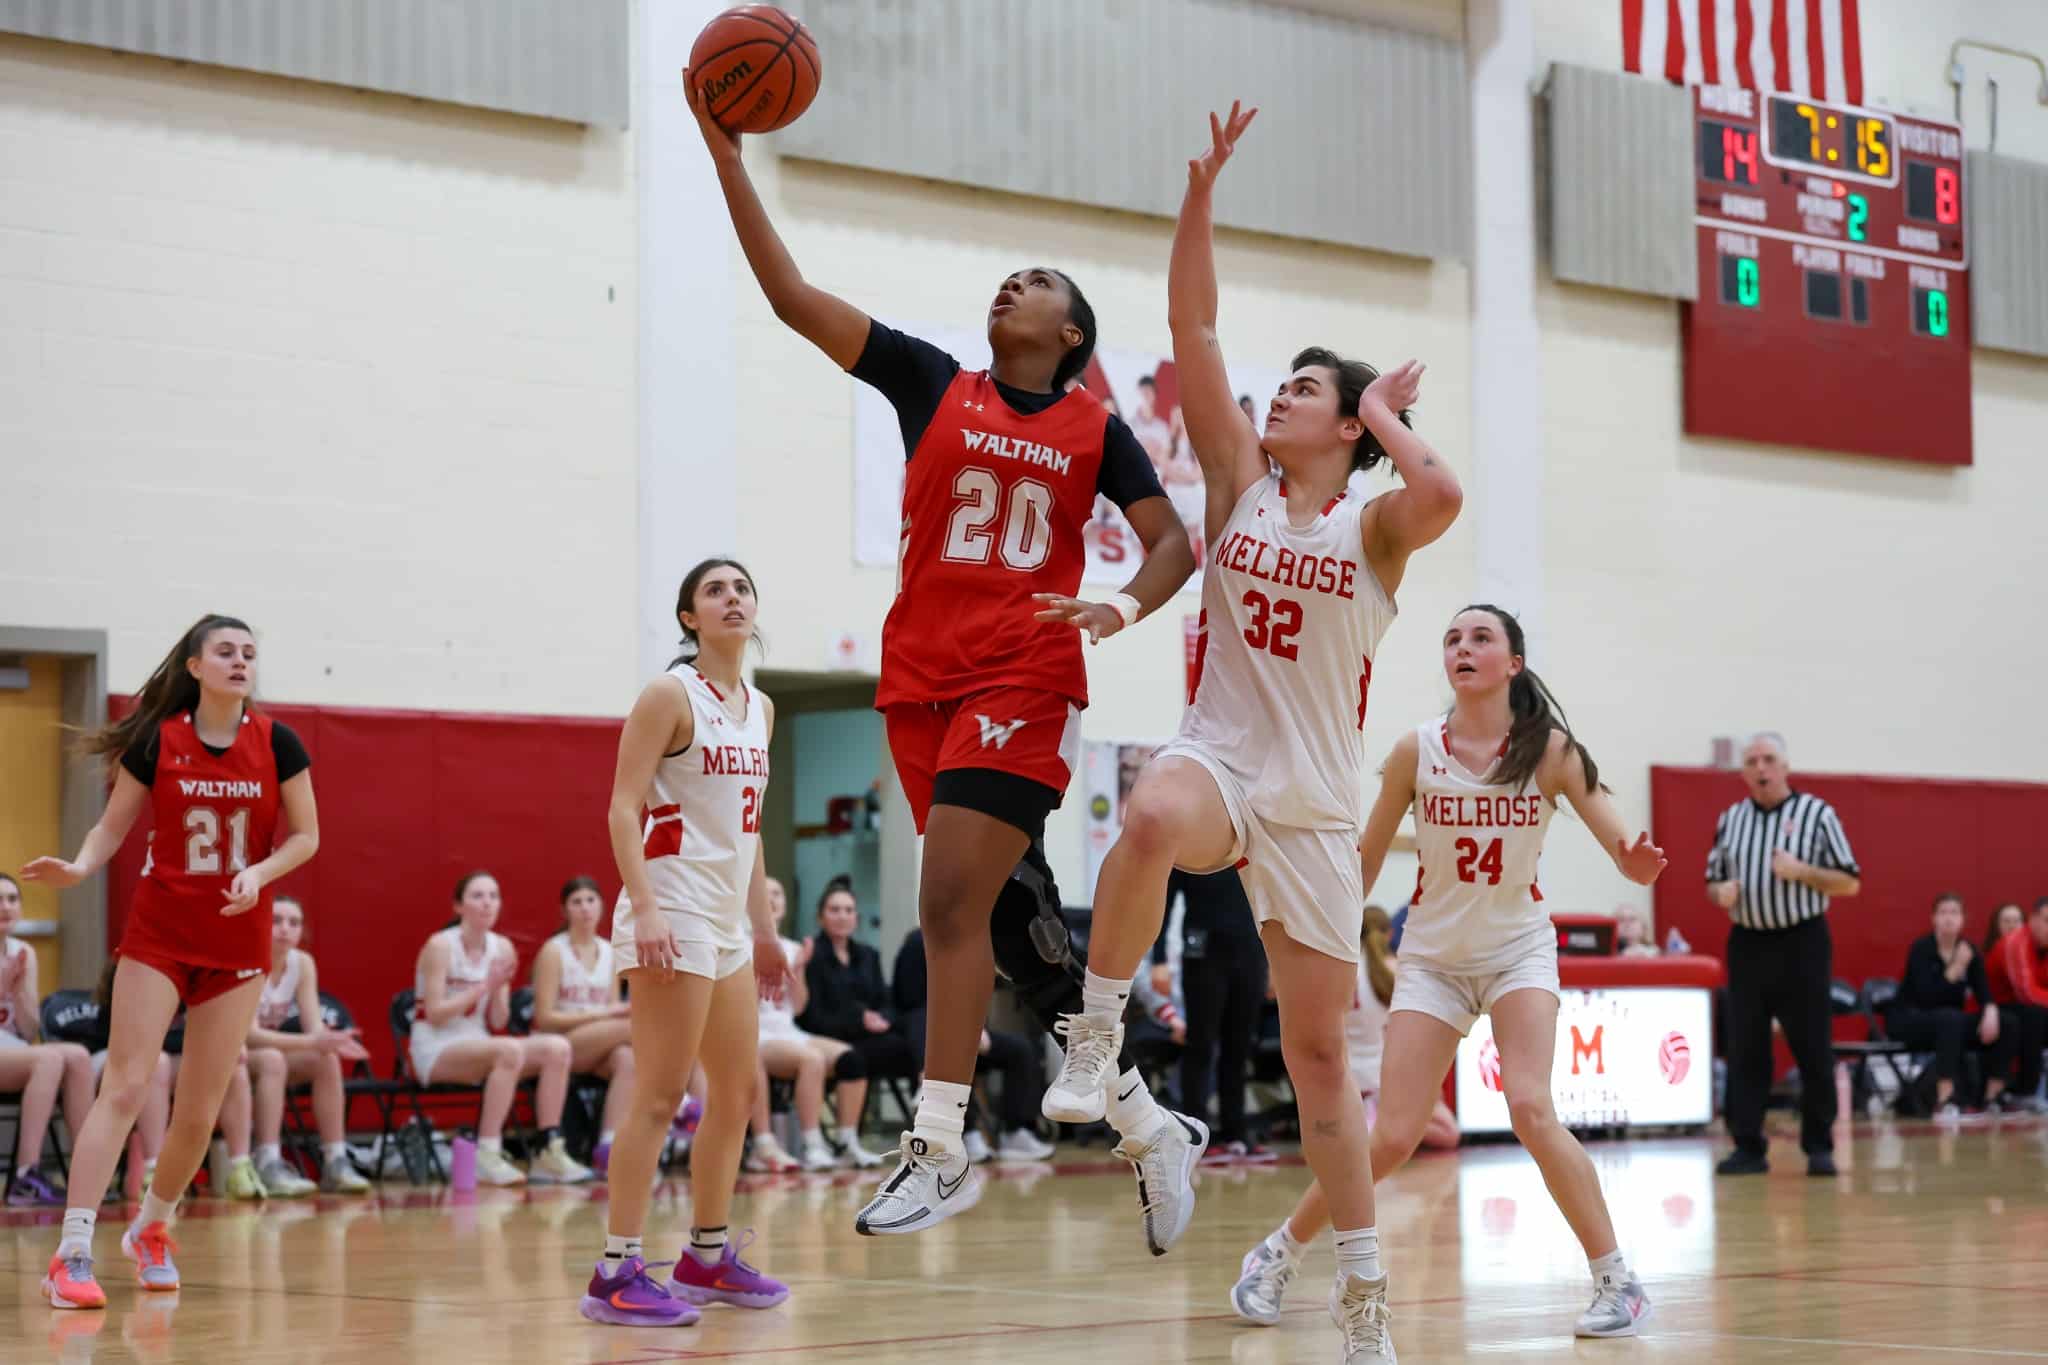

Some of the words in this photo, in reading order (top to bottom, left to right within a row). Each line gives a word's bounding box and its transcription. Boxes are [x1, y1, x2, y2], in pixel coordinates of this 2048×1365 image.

[1722, 126, 1759, 185] 14
[1796, 103, 1889, 177] 7:15
[1846, 192, 1869, 242] 2
[1935, 167, 1959, 225] 8
[1737, 256, 1760, 308] 0
[1926, 287, 1949, 337] 0
[959, 428, 1073, 477] WALTHAM
[940, 465, 1056, 573] 20
[1214, 531, 1358, 601] MELROSE
[1242, 589, 1304, 662] 32
[974, 713, 1028, 751] W
[178, 779, 262, 799] WALTHAM
[1422, 792, 1542, 828] MELROSE
[182, 805, 251, 875] 21
[1454, 836, 1504, 886] 24
[1570, 1024, 1605, 1076] M
